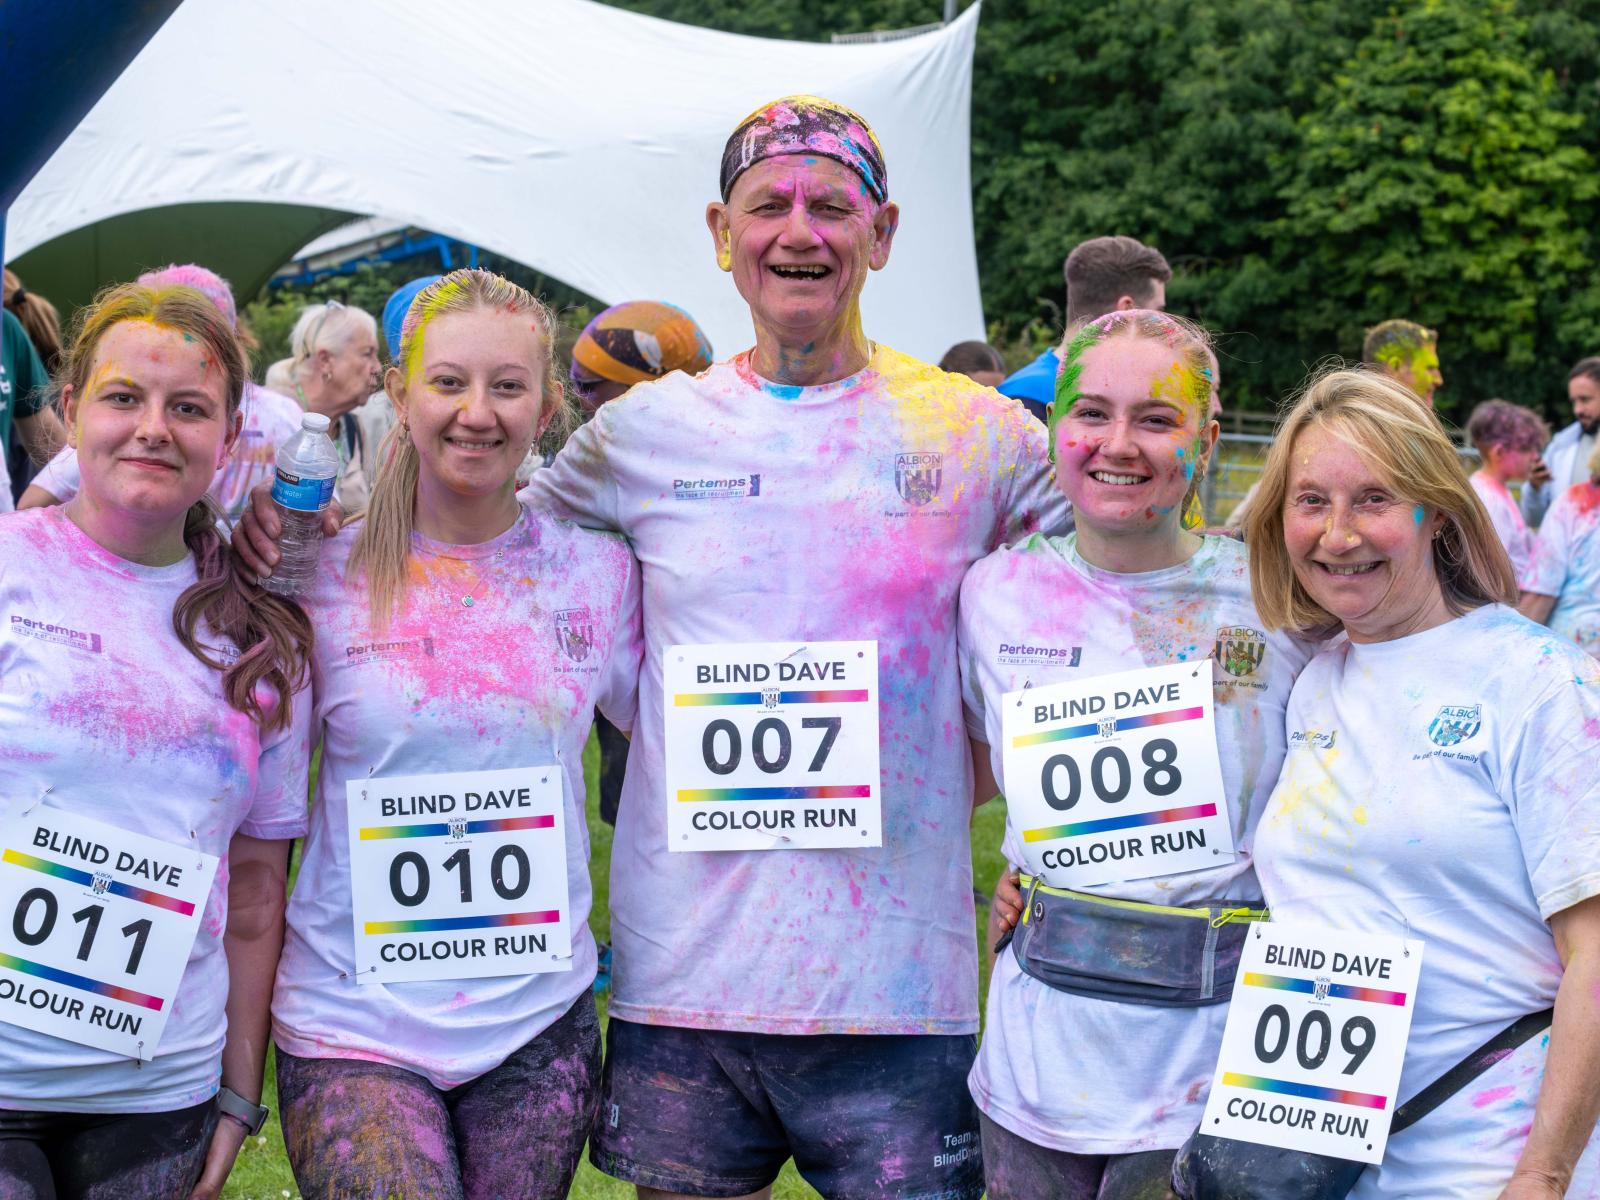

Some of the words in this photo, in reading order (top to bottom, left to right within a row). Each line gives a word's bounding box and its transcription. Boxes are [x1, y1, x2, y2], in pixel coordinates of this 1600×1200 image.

[897, 454, 941, 466] ALBION
[673, 477, 746, 490] Pertemps
[10, 615, 88, 640] Pertemps
[1220, 628, 1265, 638] ALBION
[345, 641, 420, 657] Pertemp
[998, 643, 1068, 658] Pertemps
[696, 663, 770, 684] BLIND
[778, 661, 846, 682] DAVE
[1034, 695, 1106, 724] BLIND
[1113, 682, 1181, 711] DAVE
[701, 716, 842, 776] 007
[1290, 731, 1330, 741] Perps
[1433, 749, 1442, 758] of
[1442, 751, 1455, 759] our
[1456, 752, 1479, 764] family
[1040, 738, 1182, 811] 008
[381, 794, 456, 817] BLIND
[464, 788, 532, 812] DAVE
[691, 809, 796, 831] COLOUR
[803, 808, 857, 829] RUN
[33, 826, 110, 865] BLIND
[115, 852, 183, 888] DAVE
[1041, 837, 1143, 870] COLOUR
[1150, 828, 1207, 855] RUN
[389, 843, 531, 907] 010
[12, 887, 153, 976] 011
[379, 938, 487, 963] COLOUR
[494, 933, 547, 956] RUN
[1265, 944, 1326, 970] BLIND
[1331, 952, 1392, 980] DAVE
[0, 978, 84, 1020] OLOUR
[89, 1004, 142, 1036] RUN
[1254, 1003, 1376, 1076] 009
[1226, 1096, 1317, 1131] COLOUR
[1320, 1112, 1369, 1139] RUN
[943, 1131, 971, 1148] Team
[933, 1147, 978, 1168] BlindD
